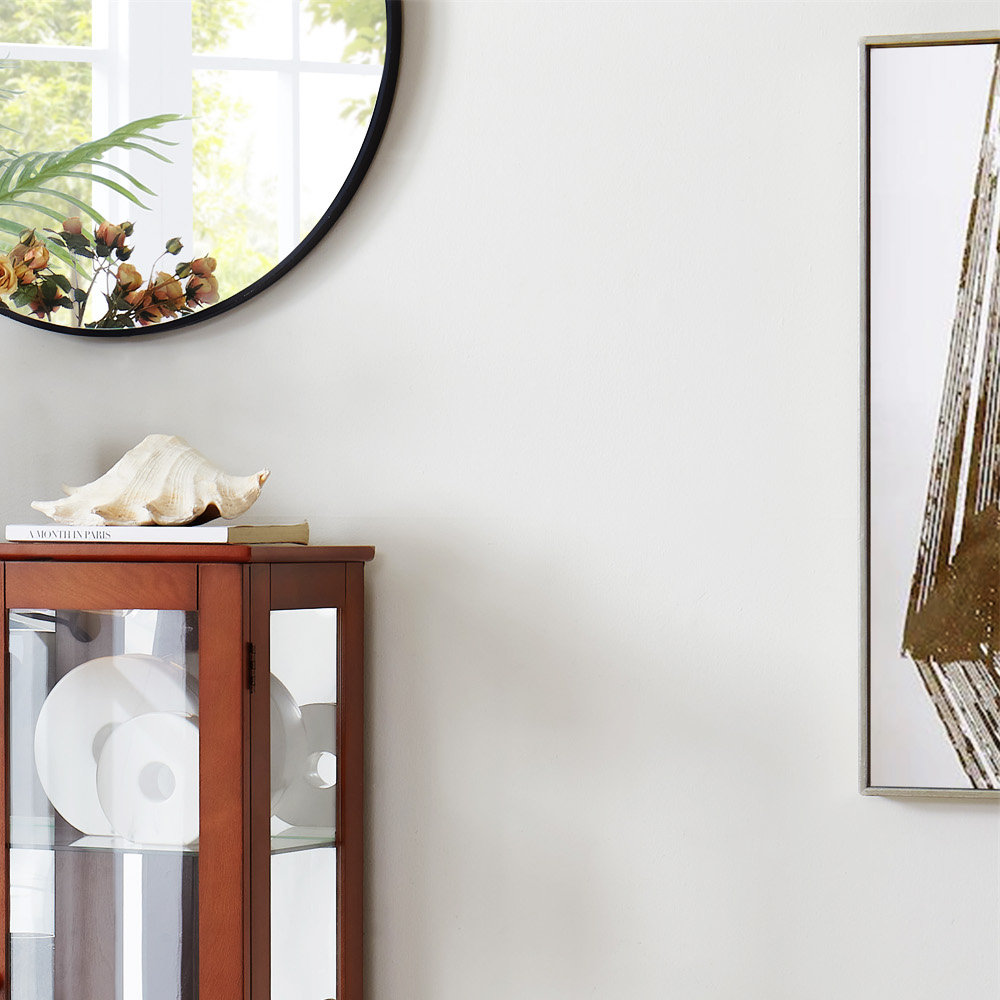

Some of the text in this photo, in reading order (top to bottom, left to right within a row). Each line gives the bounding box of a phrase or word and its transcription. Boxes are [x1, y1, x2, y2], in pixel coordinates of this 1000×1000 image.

[36, 530, 71, 539] MONTH
[73, 530, 83, 539] IN
[84, 530, 112, 539] PARIS
